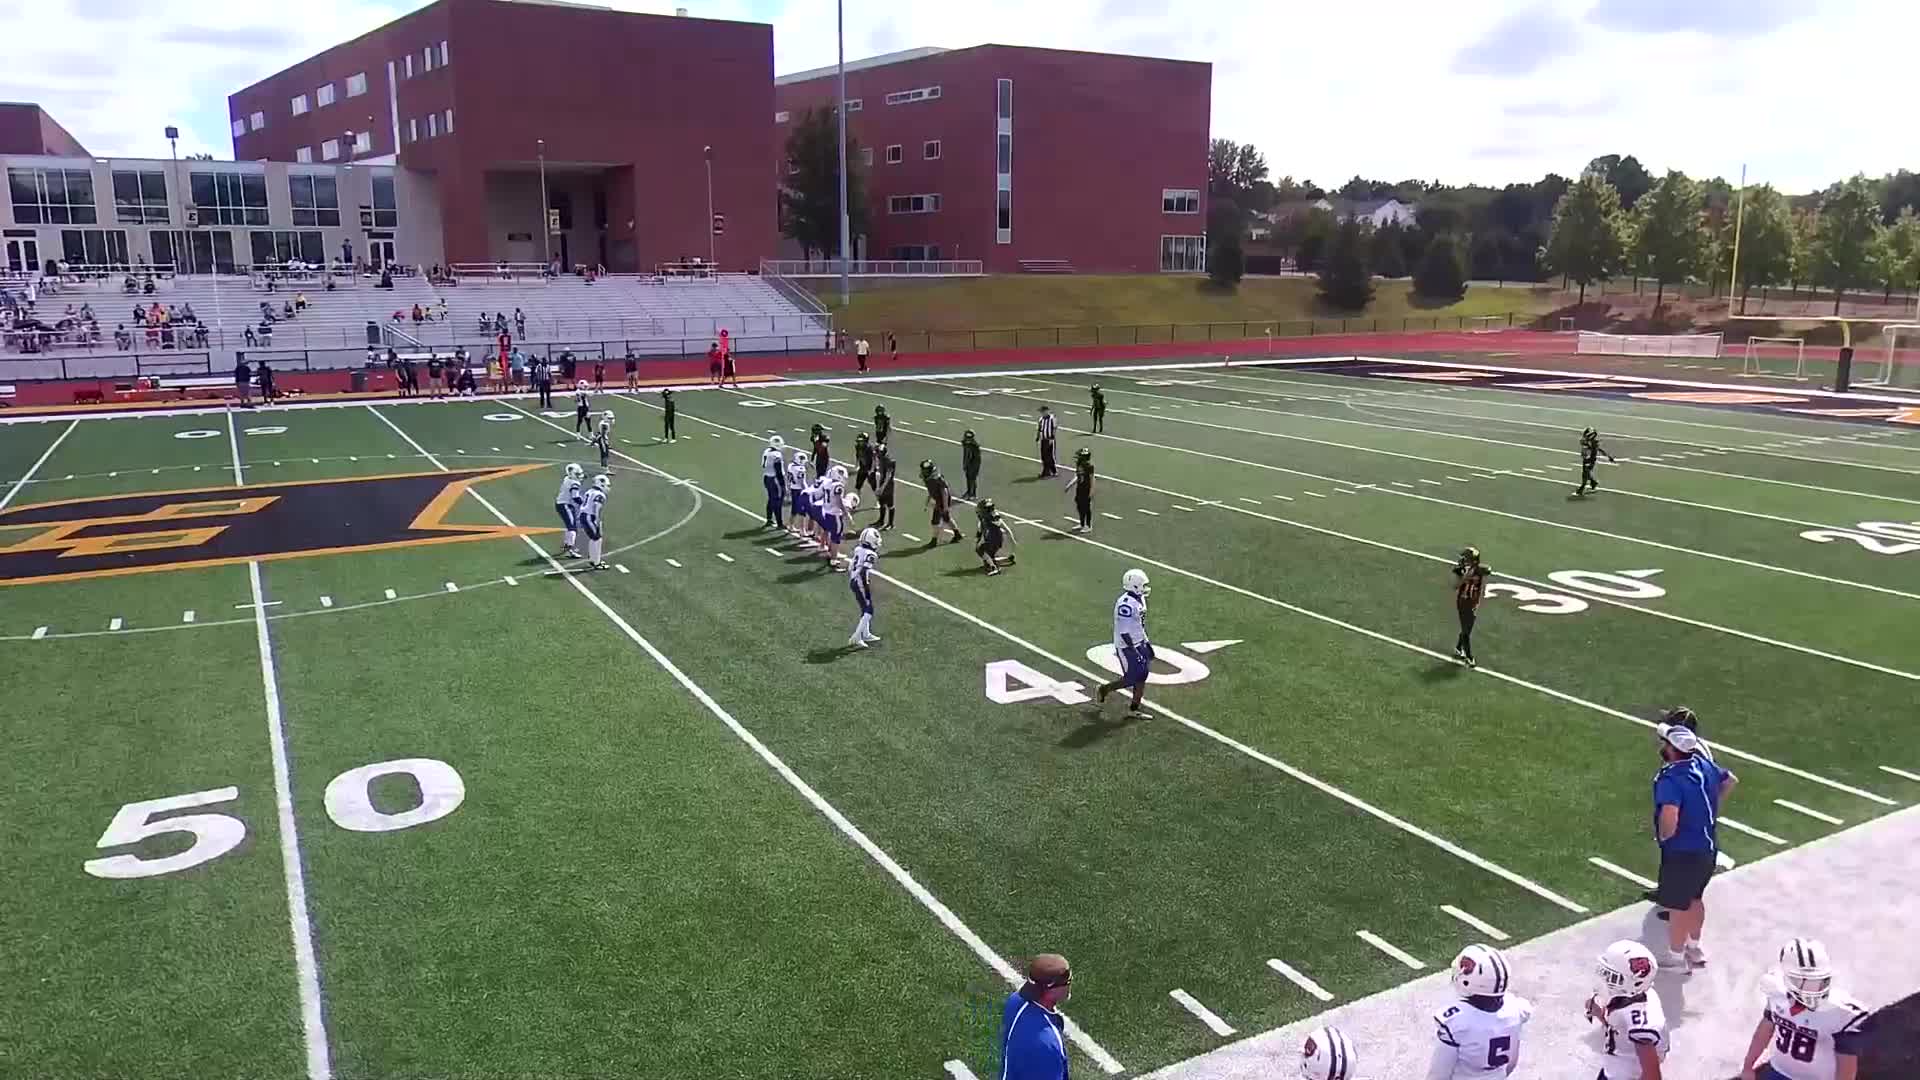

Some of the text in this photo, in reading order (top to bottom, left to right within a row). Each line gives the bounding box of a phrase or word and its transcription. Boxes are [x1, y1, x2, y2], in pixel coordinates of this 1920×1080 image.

[1484, 570, 1666, 614] 30
[1631, 1010, 1648, 1025] 21
[1488, 1035, 1511, 1067] 5
